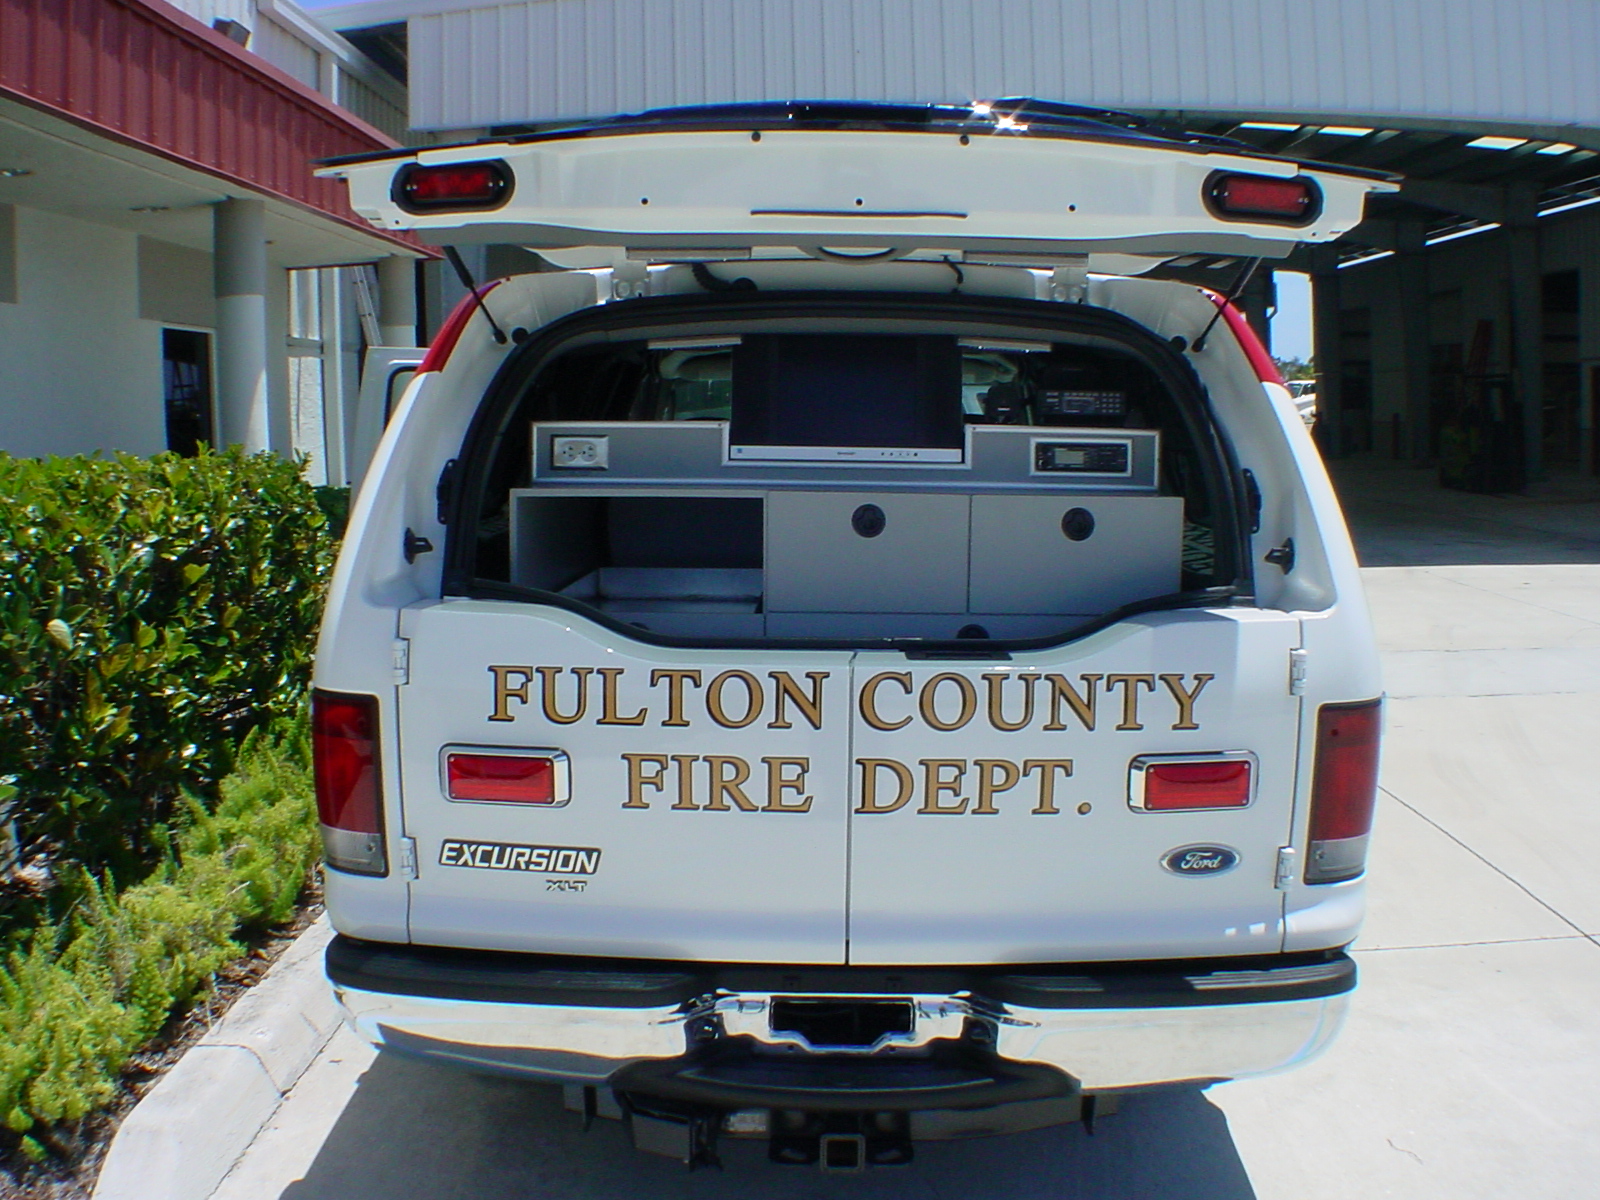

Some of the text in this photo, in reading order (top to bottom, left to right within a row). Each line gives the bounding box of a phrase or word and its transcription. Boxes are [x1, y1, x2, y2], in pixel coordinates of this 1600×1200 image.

[487, 664, 1215, 732] FULTON COUNTY
[620, 752, 1093, 815] FIRE DEPT.
[440, 841, 600, 875] EXCURSION
[1180, 851, 1223, 870] Ford
[545, 879, 588, 893] XLT
